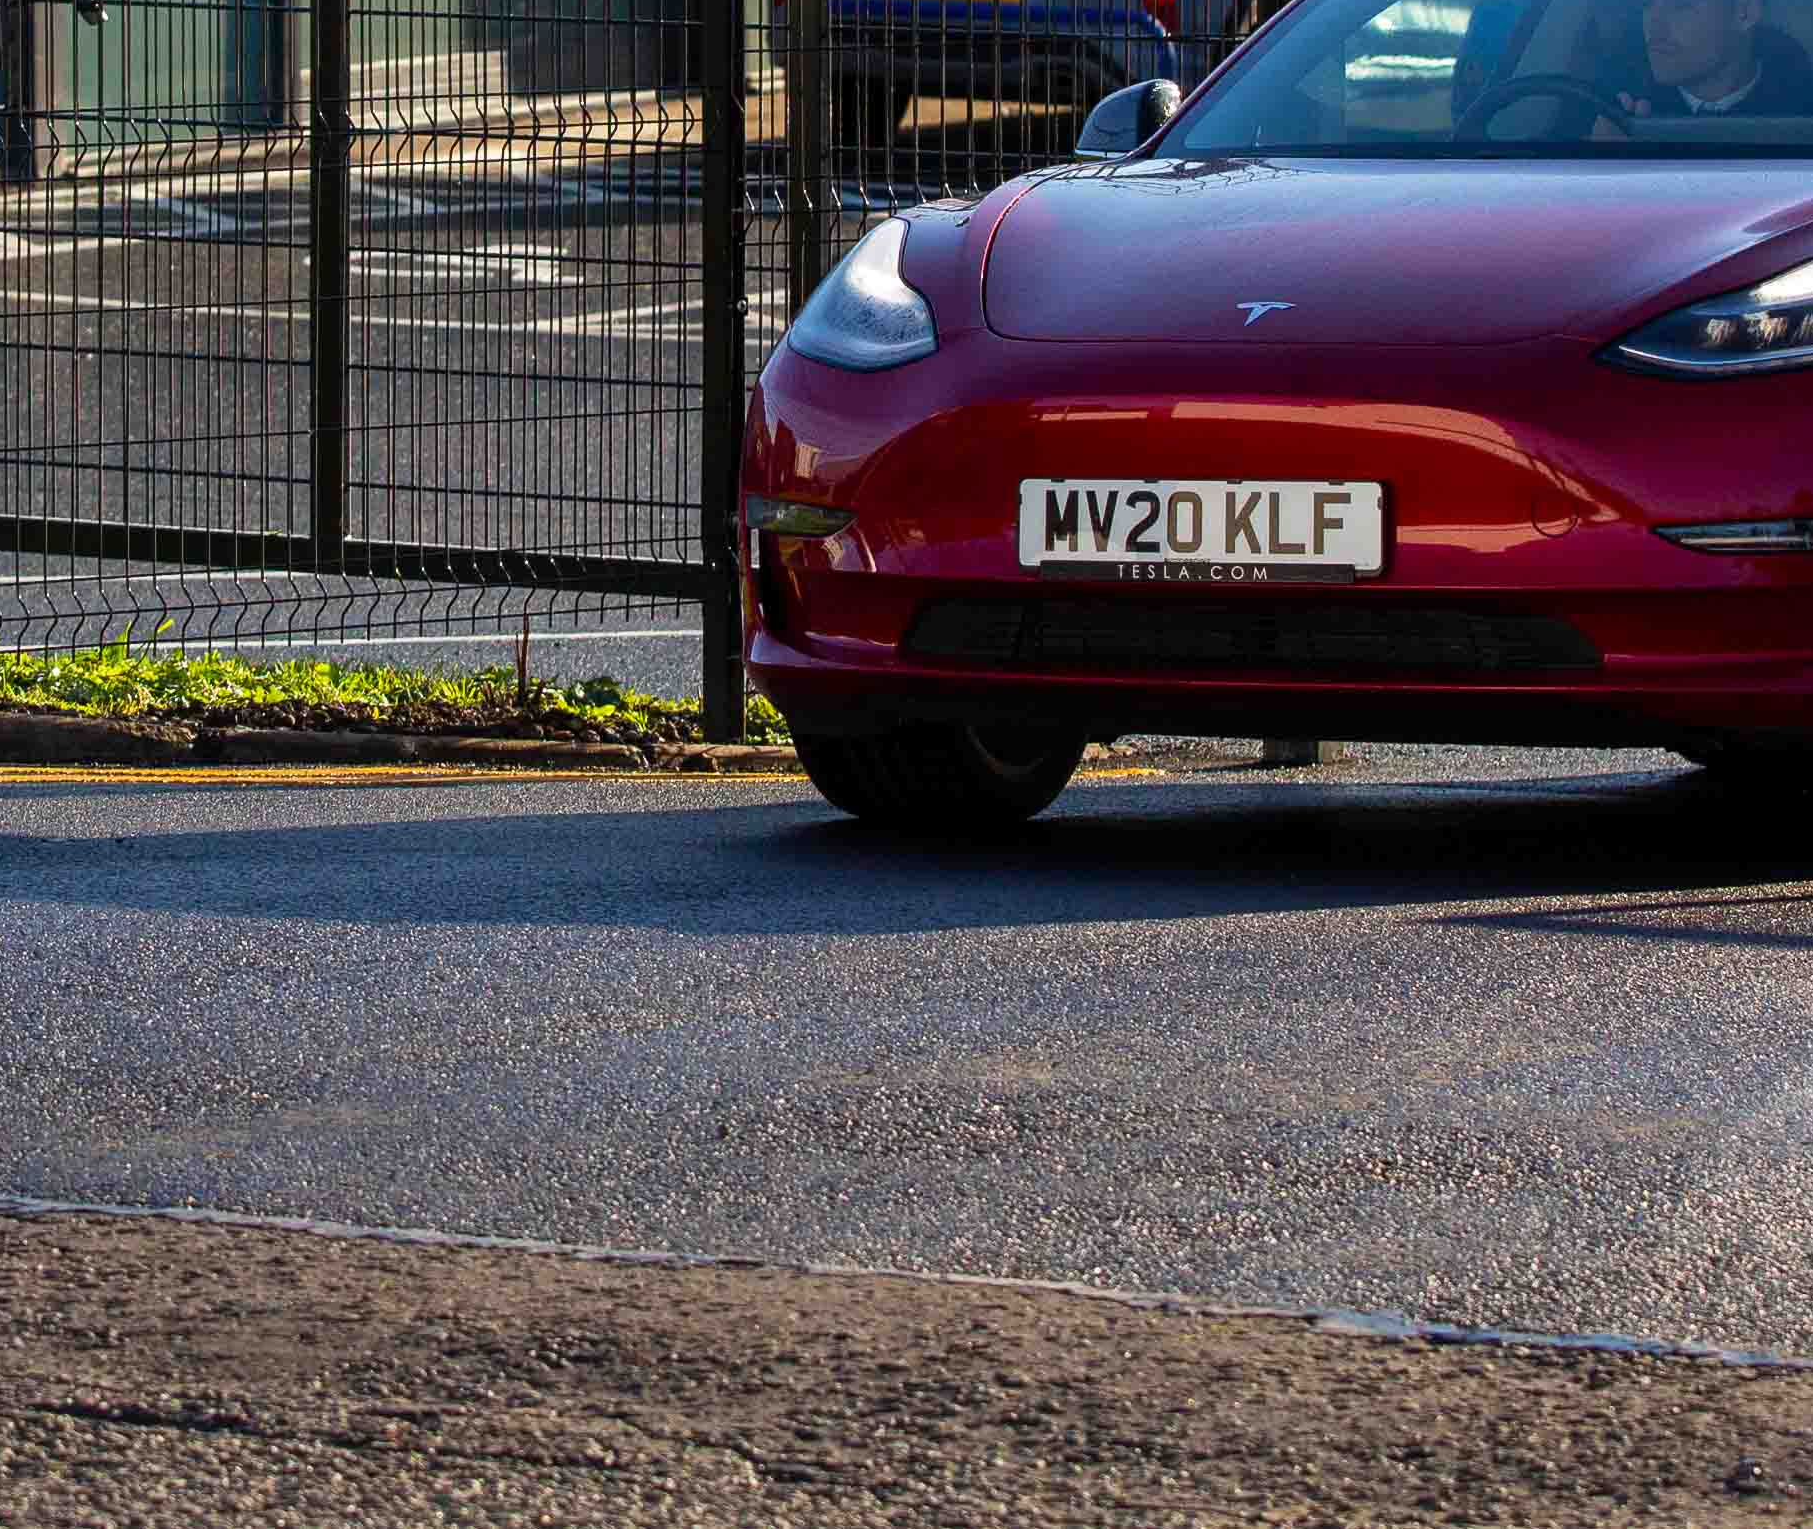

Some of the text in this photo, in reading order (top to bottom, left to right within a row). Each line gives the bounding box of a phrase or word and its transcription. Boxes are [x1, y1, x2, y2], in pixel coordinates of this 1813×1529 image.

[1045, 490, 1352, 555] MV20 KLF
[1117, 563, 1268, 581] TESLA.COM
